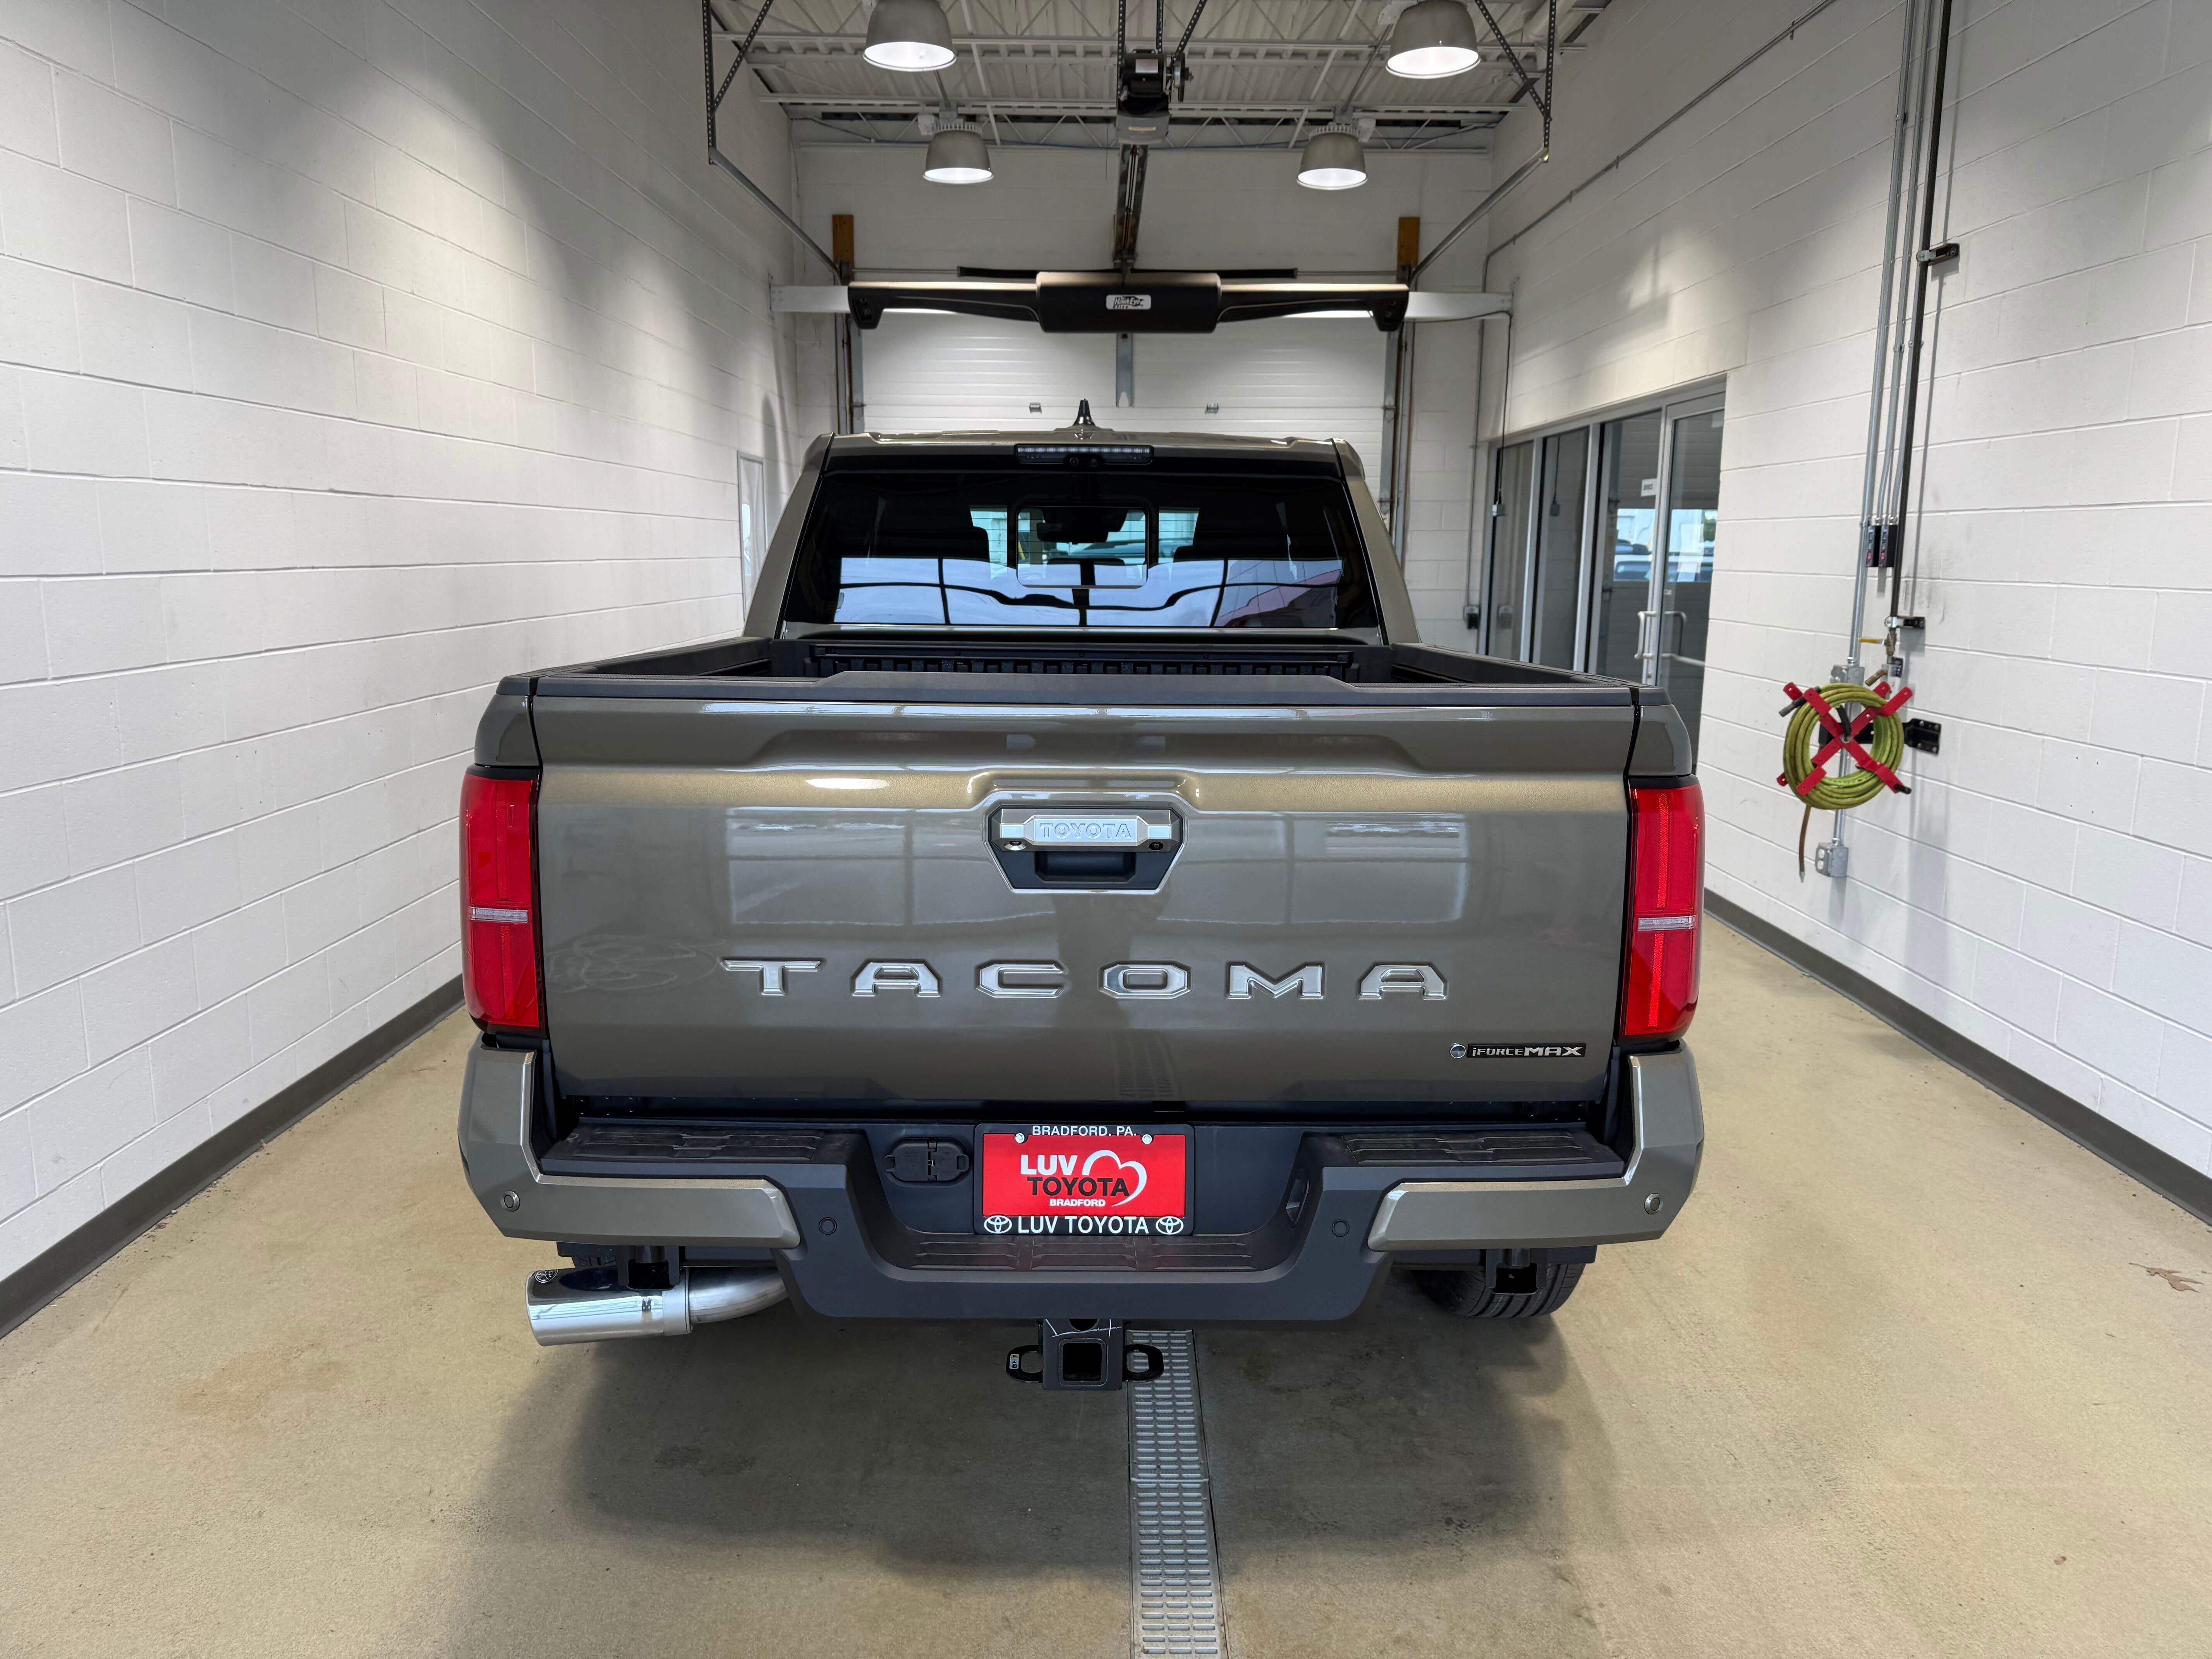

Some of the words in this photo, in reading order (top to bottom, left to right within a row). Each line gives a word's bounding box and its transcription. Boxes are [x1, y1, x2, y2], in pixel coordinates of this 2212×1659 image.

[1040, 823, 1132, 839] TOYOTA
[721, 958, 1446, 999] TACOMA
[1032, 1125, 1111, 1137] BRADFORD,
[1117, 1125, 1137, 1137] PA.
[1020, 1154, 1078, 1176] LUV
[1027, 1177, 1130, 1197] TOYOTA
[1049, 1199, 1106, 1207] BRADFORD
[1018, 1216, 1058, 1234] LUV
[1065, 1216, 1149, 1234] TOYOTA
